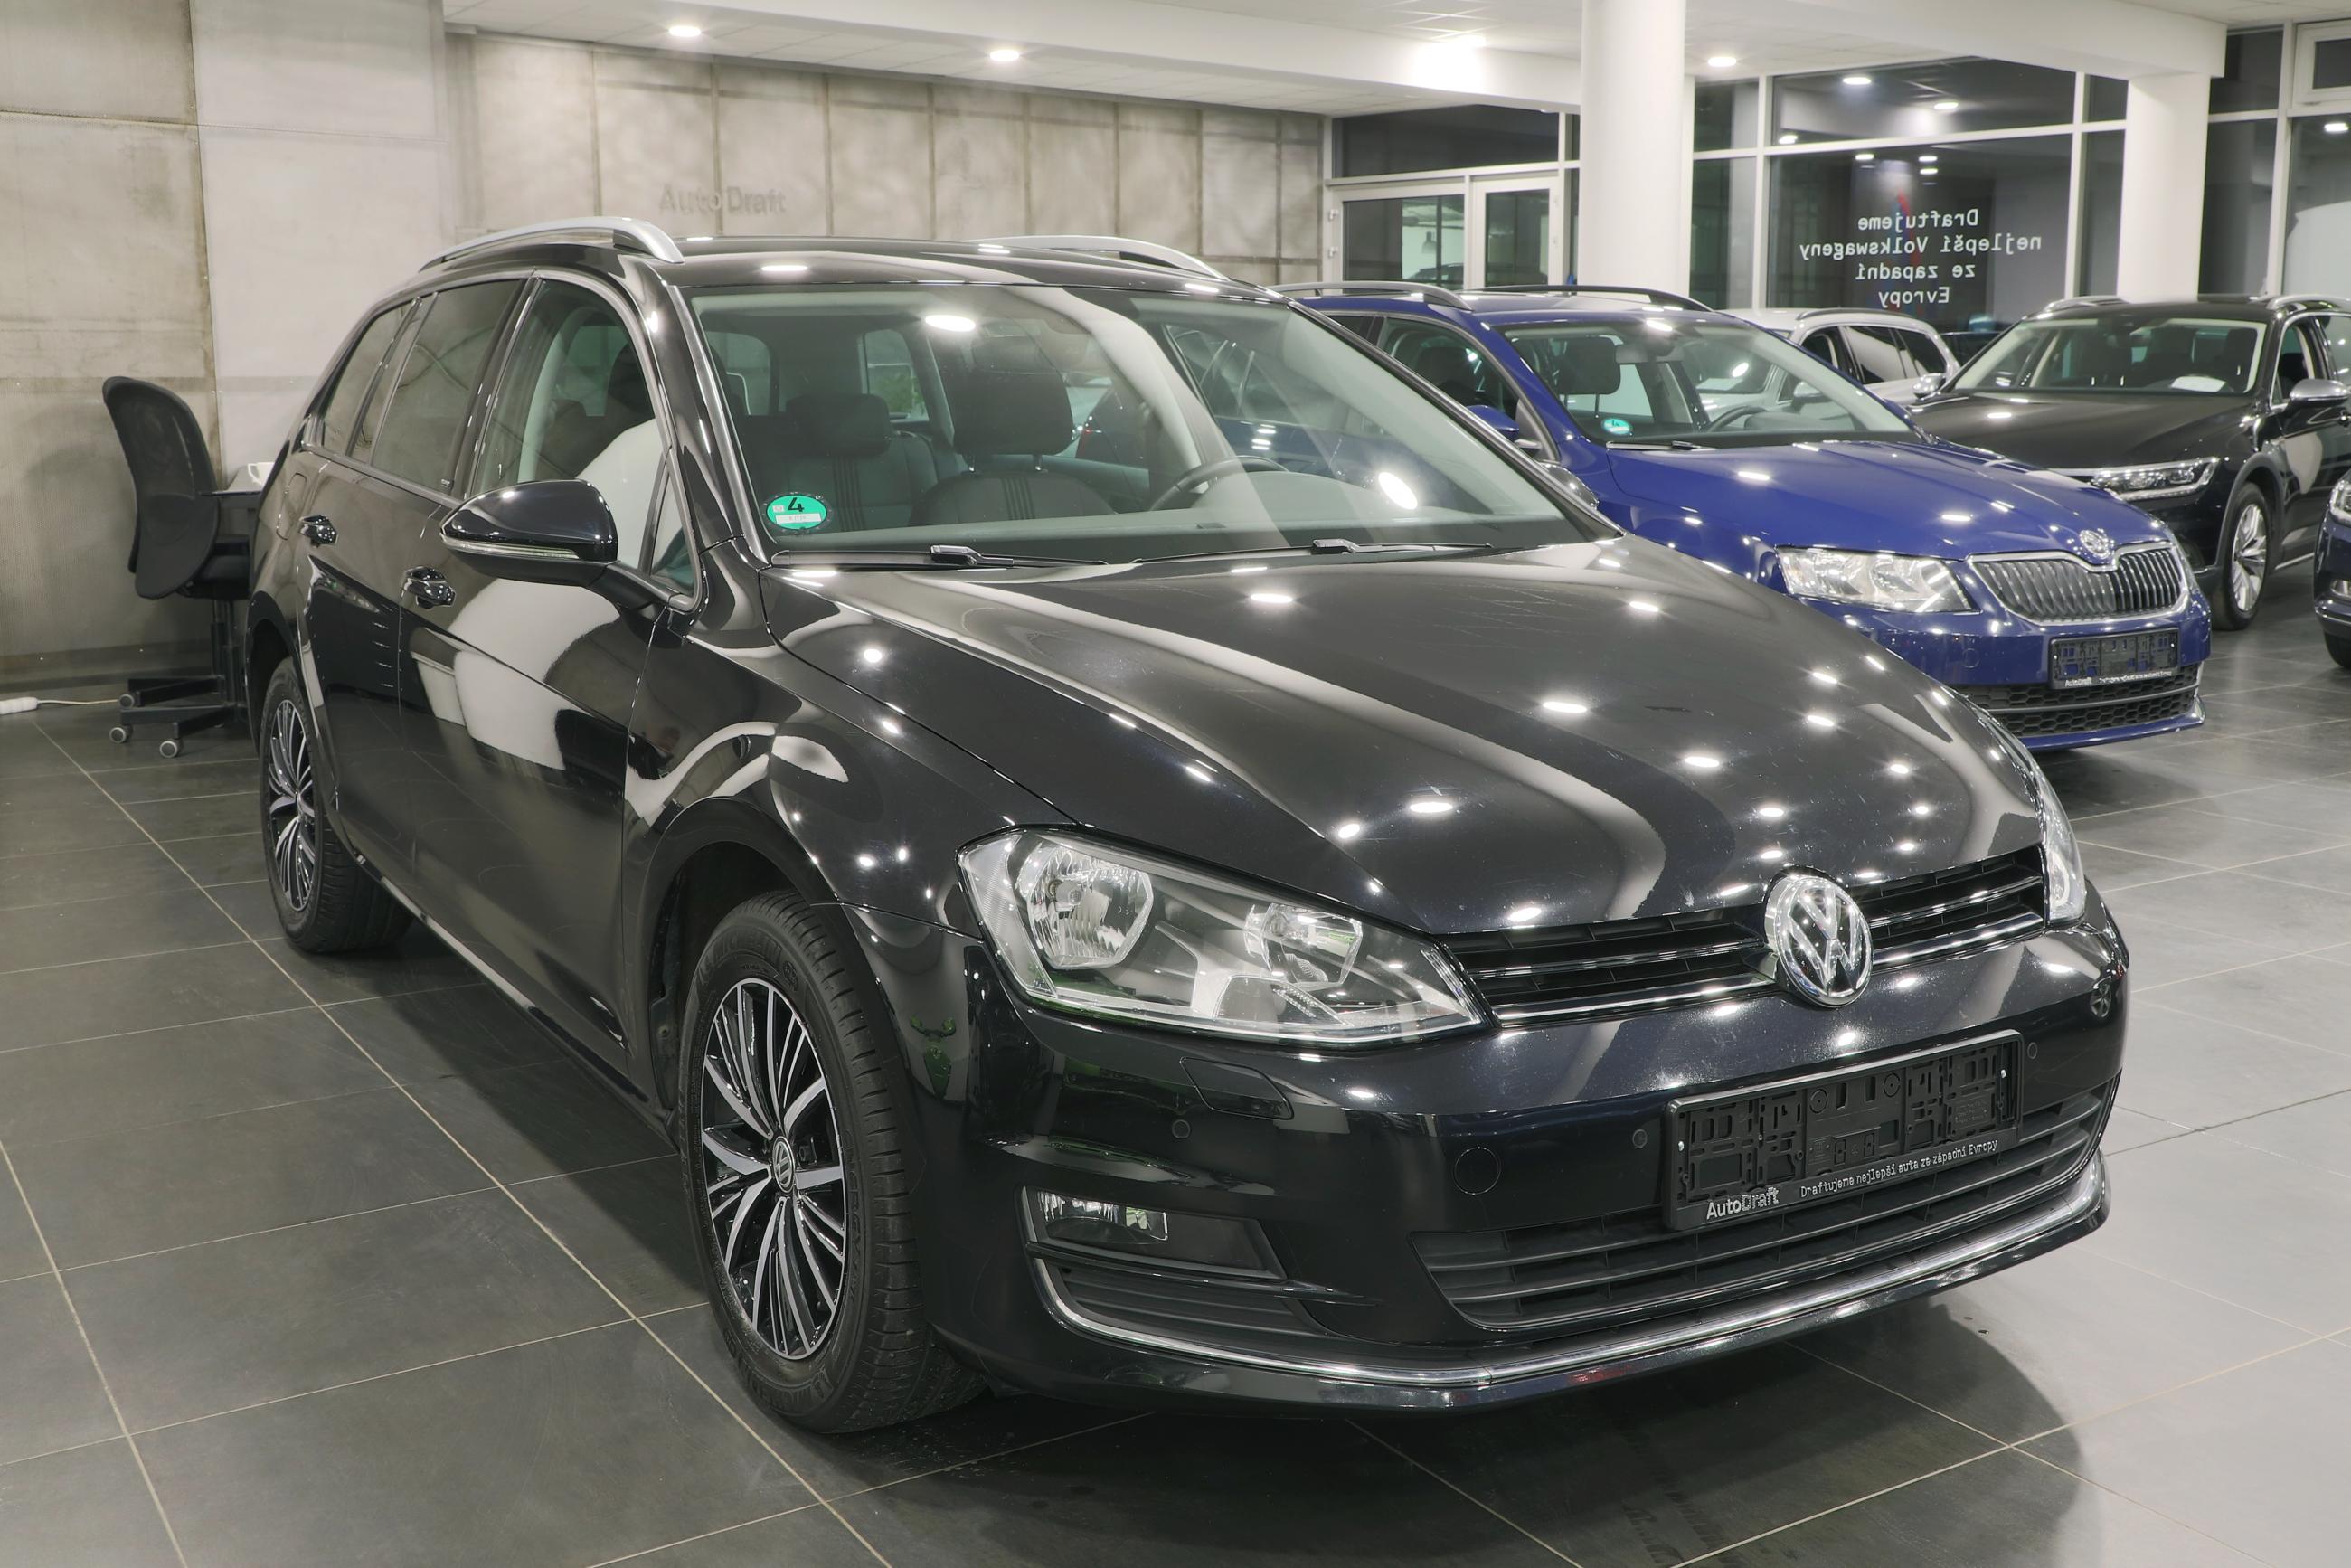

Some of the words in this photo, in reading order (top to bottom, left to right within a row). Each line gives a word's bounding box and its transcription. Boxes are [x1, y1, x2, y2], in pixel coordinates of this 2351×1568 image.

[788, 496, 805, 513] 4
[1800, 1177, 1855, 1198] Draftujeme
[1856, 1163, 1896, 1185] nejlepší
[1898, 1159, 1919, 1174] auta
[1921, 1157, 1931, 1167] ze
[1932, 1146, 1967, 1165] západní
[1968, 1139, 1998, 1156] Evropy
[1706, 1186, 1780, 1220] AutoDraft
